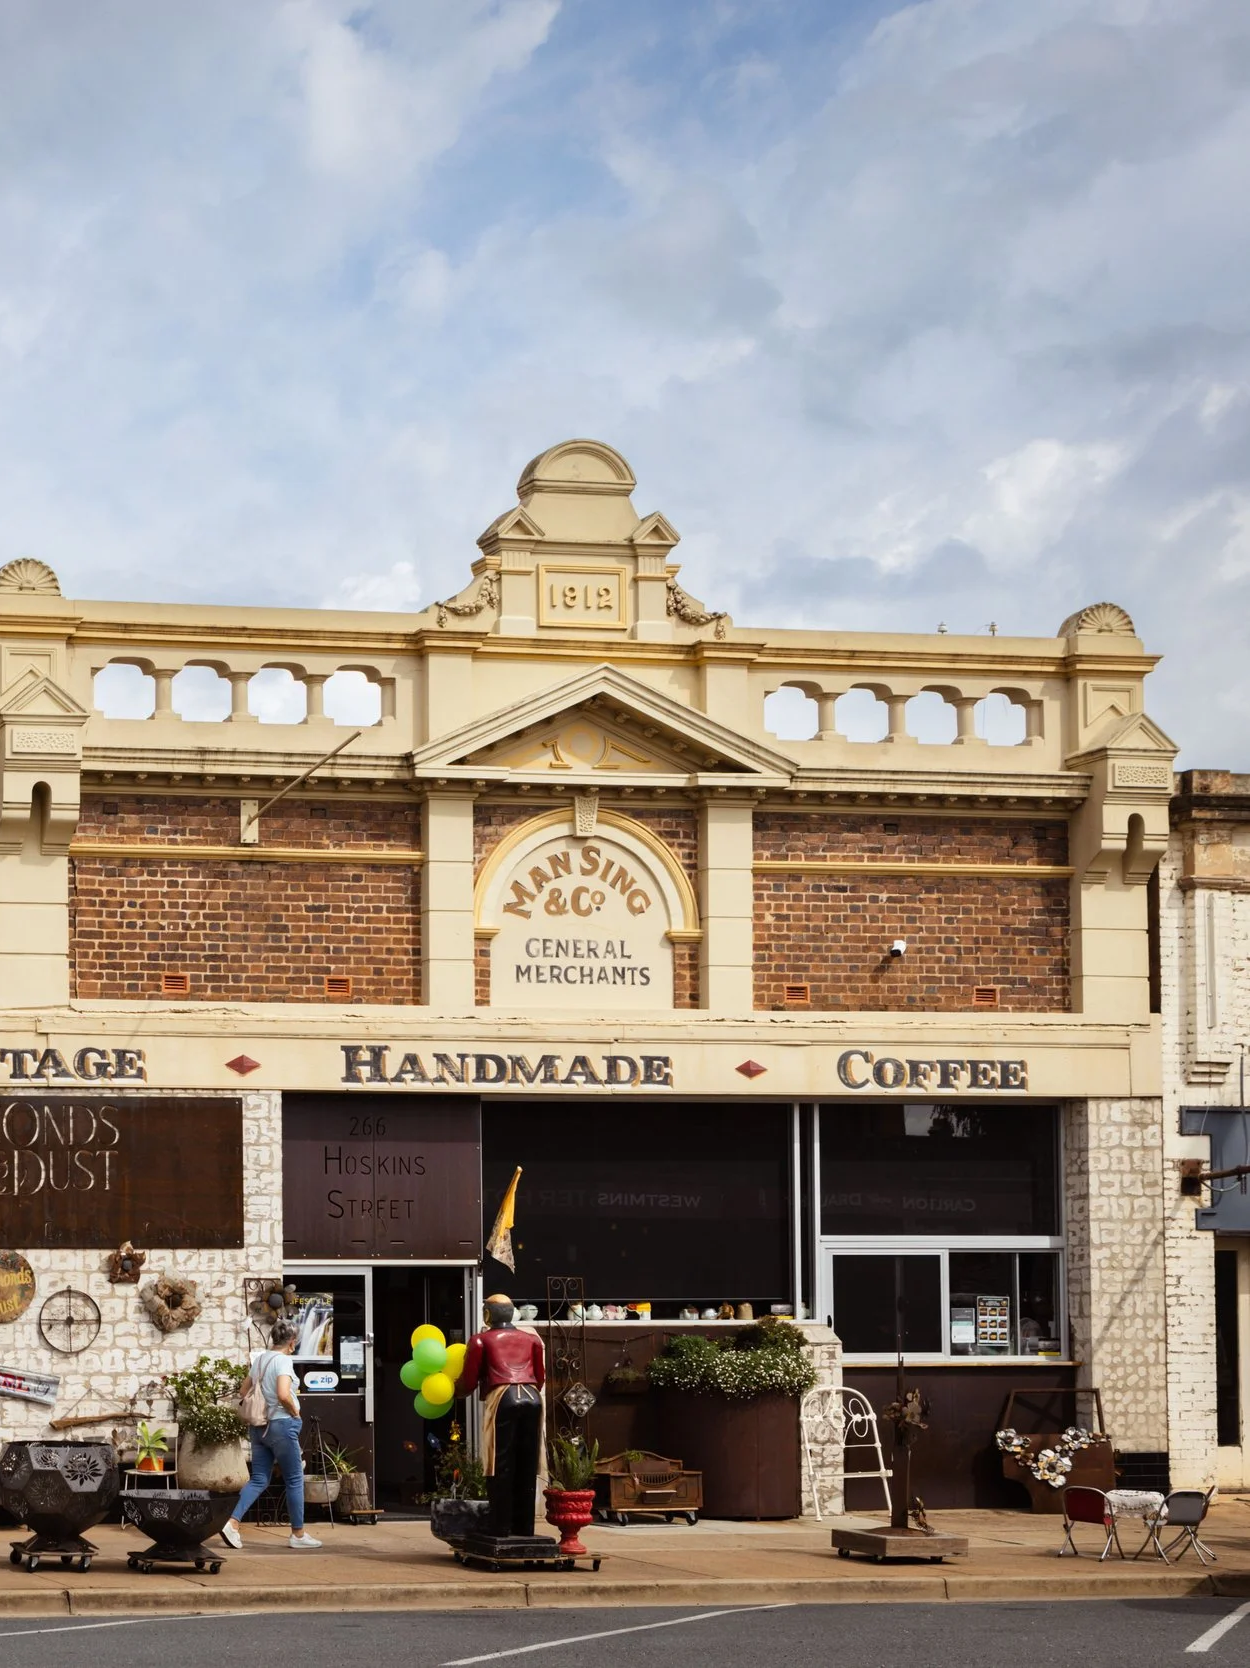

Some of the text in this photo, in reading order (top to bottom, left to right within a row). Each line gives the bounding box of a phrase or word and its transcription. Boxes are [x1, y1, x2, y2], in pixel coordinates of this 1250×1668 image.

[550, 584, 613, 610] 1912
[525, 938, 632, 959] GENERAL
[515, 964, 651, 986] MERCHANTS
[340, 1044, 674, 1087] HANDMADE
[837, 1050, 1029, 1091] COFFEE
[350, 1117, 386, 1136] 266
[12, 1150, 119, 1196] DUST
[325, 1145, 426, 1176] HOSKINS
[327, 1189, 414, 1219] STREET
[320, 1375, 333, 1384] zip
